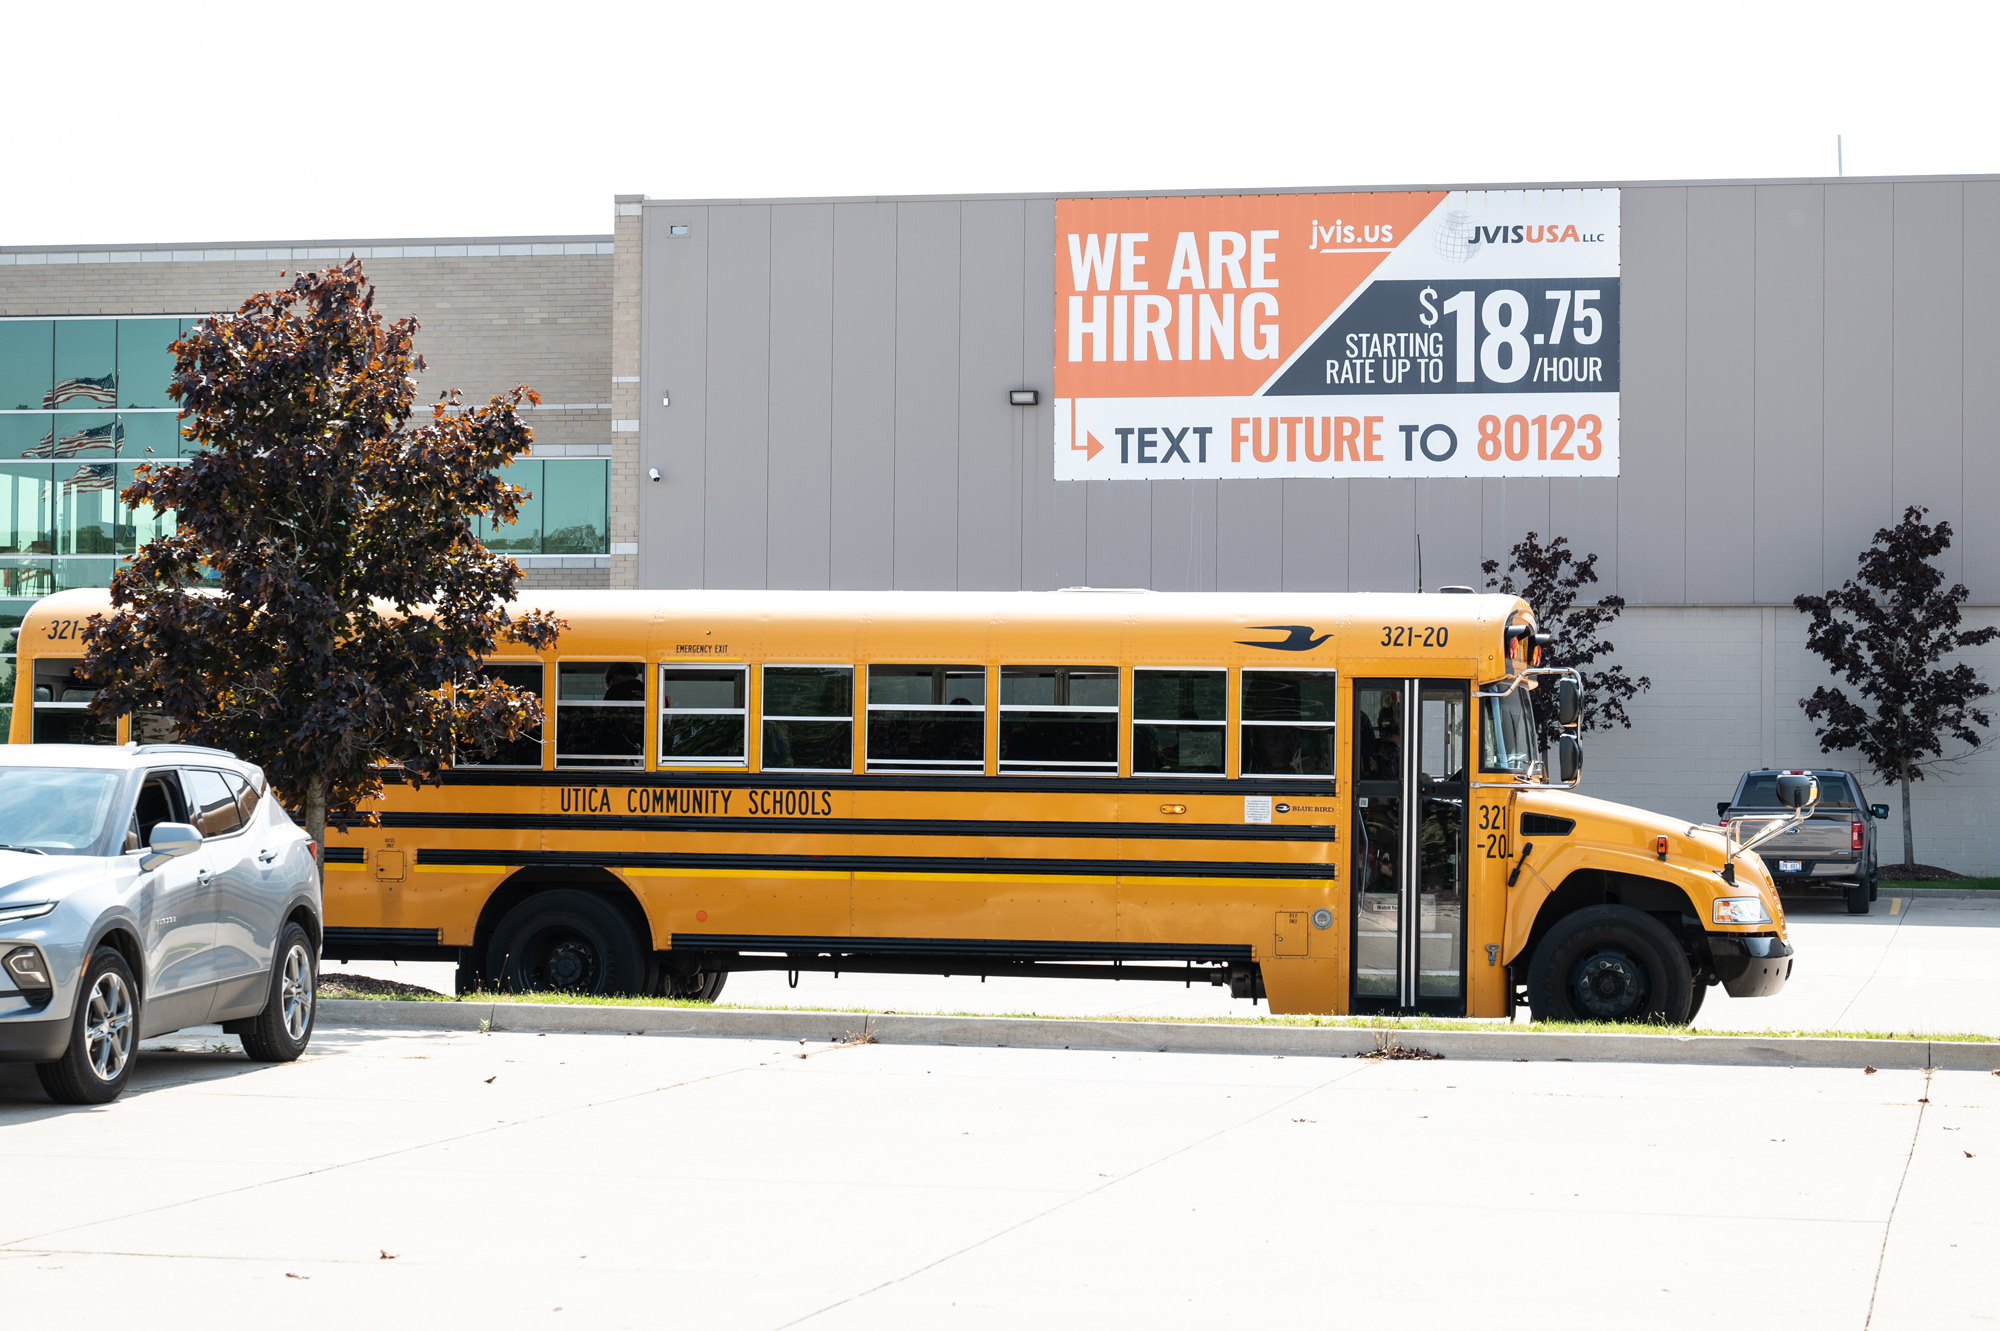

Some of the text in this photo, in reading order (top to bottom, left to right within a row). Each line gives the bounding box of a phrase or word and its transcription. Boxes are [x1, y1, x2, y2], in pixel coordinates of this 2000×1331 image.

[1309, 219, 1393, 249] jvis.us
[1468, 225, 1605, 244] JVISUSA LLC
[1068, 230, 1280, 291] WE ARE
[1068, 292, 1280, 362] HIRING
[1345, 333, 1443, 358] STARTING
[1326, 358, 1444, 384] RATE UP TO
[1533, 357, 1602, 383] /HOUR
[1115, 414, 1602, 463] TEXT FUTURE TO 80123
[47, 620, 98, 640] 321-
[1380, 626, 1449, 648] 321-20
[676, 644, 729, 654] EMERGENCY EXIT
[560, 787, 832, 816] UTICA COMMUNITY SCHOOLS
[1314, 806, 1335, 814] BIRD
[1479, 804, 1506, 830] 321
[1477, 833, 1507, 859] -20
